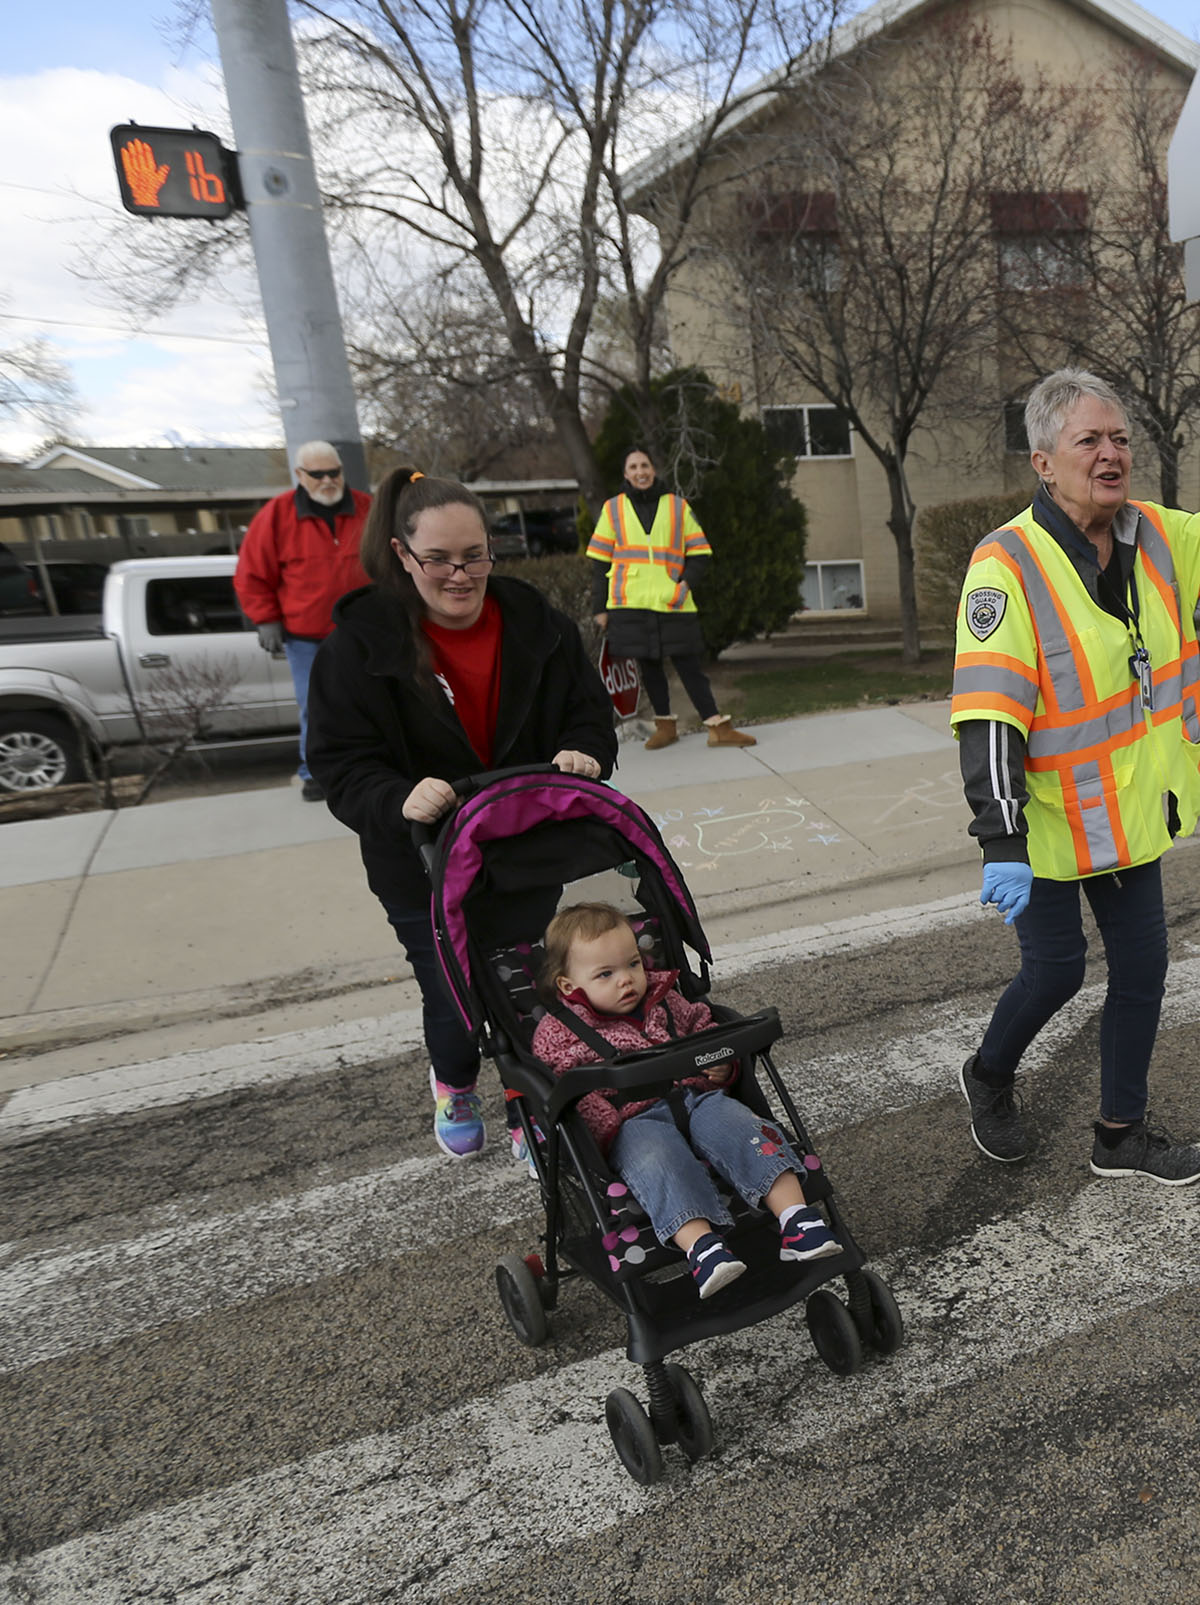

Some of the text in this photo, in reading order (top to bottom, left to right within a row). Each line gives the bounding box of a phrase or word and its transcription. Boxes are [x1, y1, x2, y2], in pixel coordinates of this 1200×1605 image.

[184, 150, 226, 204] 16
[971, 591, 1003, 600] CROSSING
[975, 597, 997, 605] GUARD
[605, 659, 637, 695] STOP
[695, 1047, 730, 1066] Kolcraft
